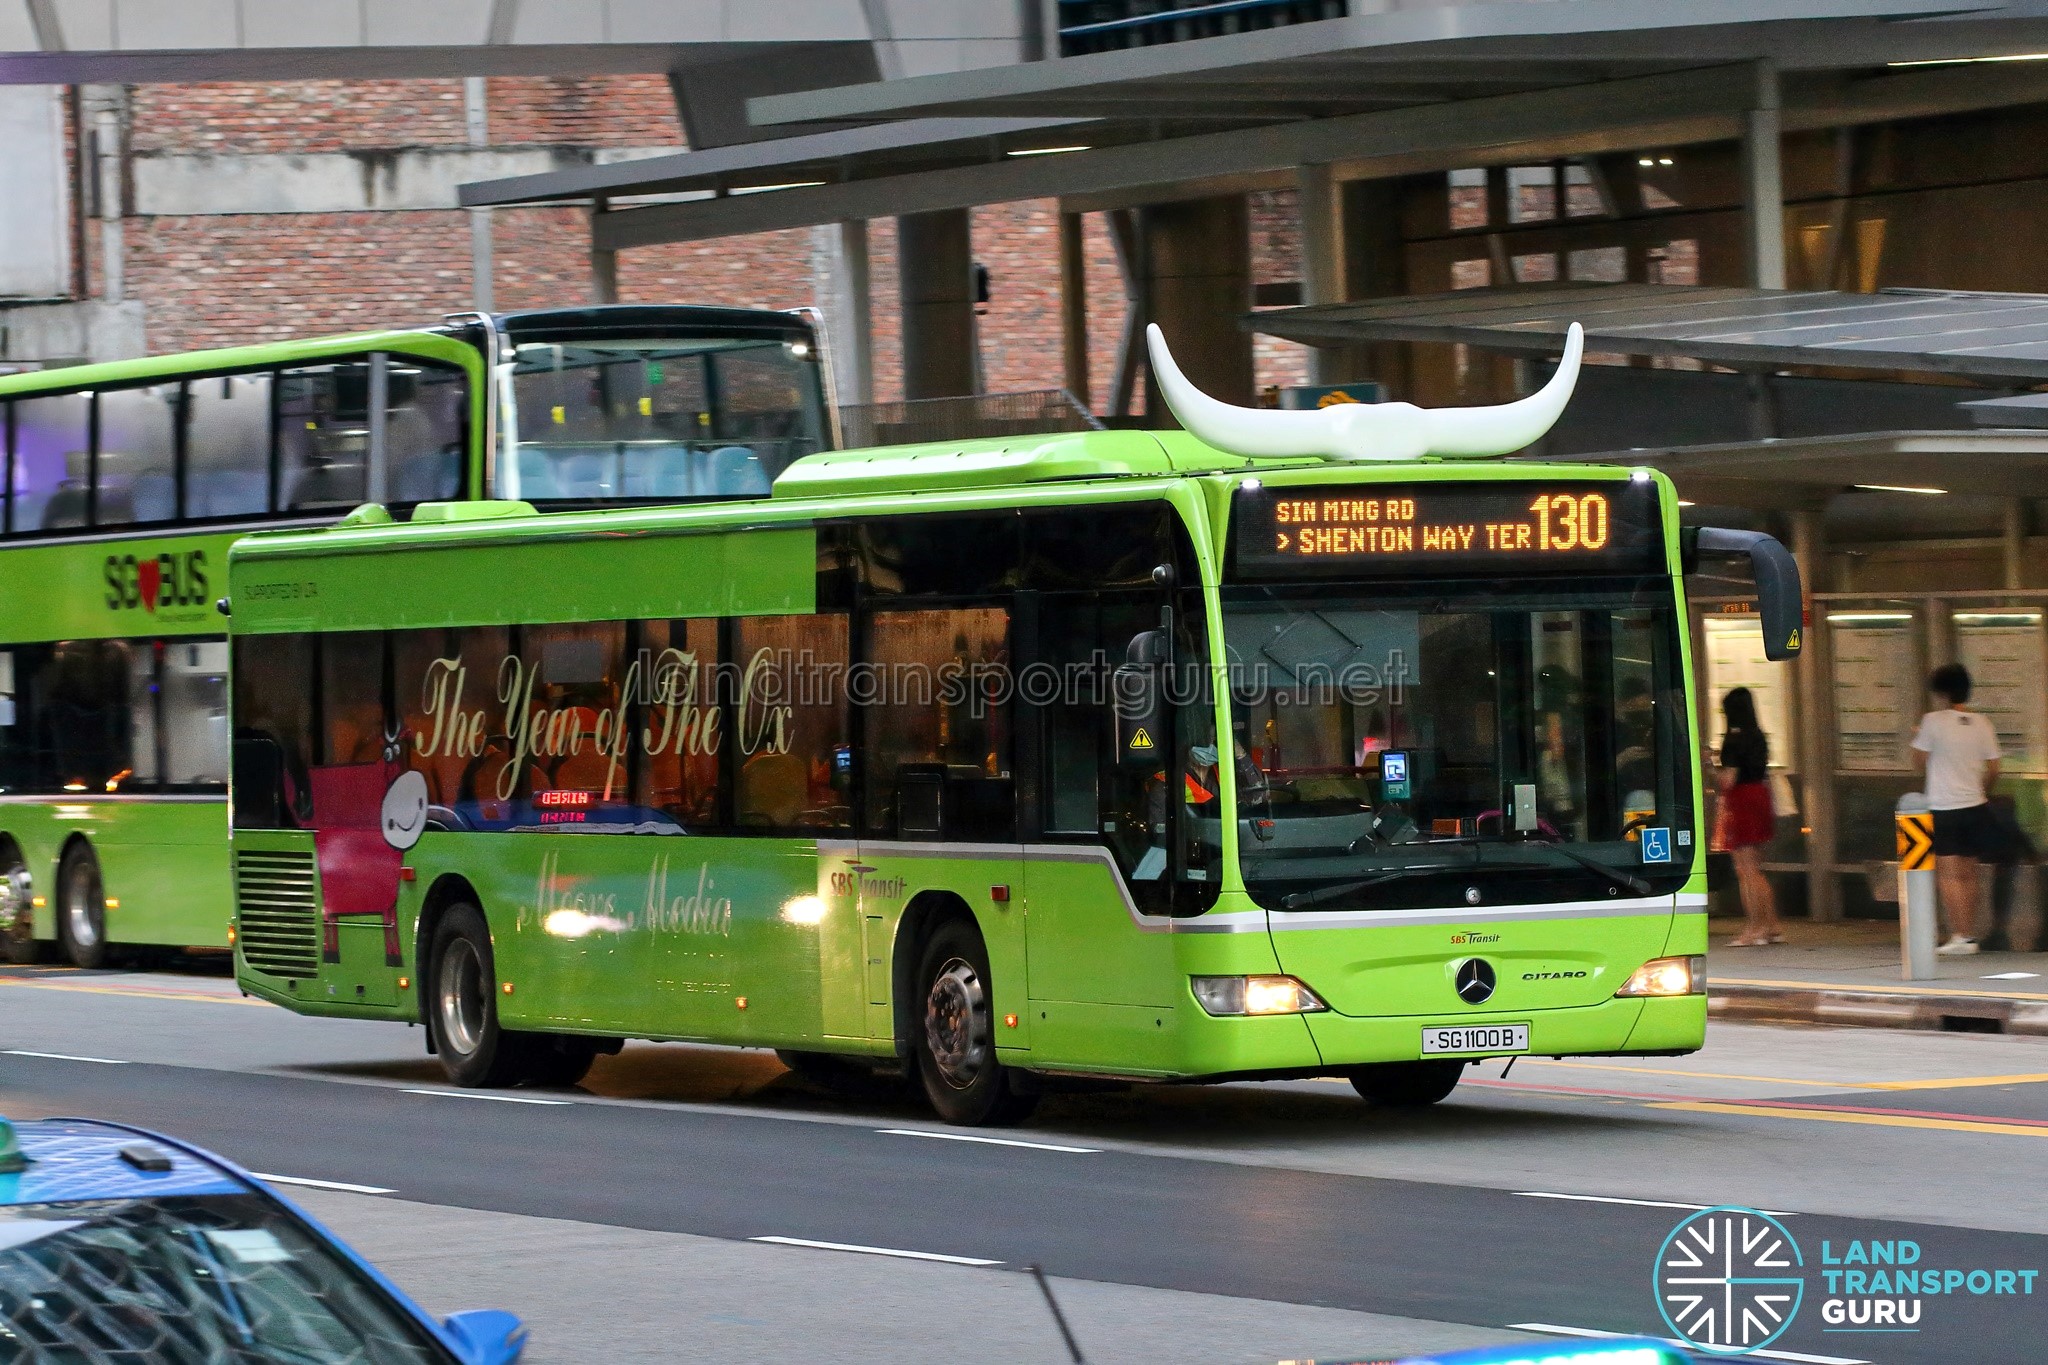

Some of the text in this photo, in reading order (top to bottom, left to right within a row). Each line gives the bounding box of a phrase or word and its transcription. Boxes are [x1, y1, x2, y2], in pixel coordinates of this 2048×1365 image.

[1277, 500, 1415, 522] SIN MING RD
[1530, 494, 1607, 550] 130
[1299, 523, 1531, 553] SHENTON WAY TER
[158, 550, 209, 606] BUS
[416, 646, 795, 801] The Year of The Ox
[831, 866, 907, 898] SBS Transit
[626, 853, 732, 946] Media
[1450, 932, 1501, 944] SBS Transit
[1521, 971, 1587, 981] CITARO
[1437, 1028, 1514, 1049] SG1100B
